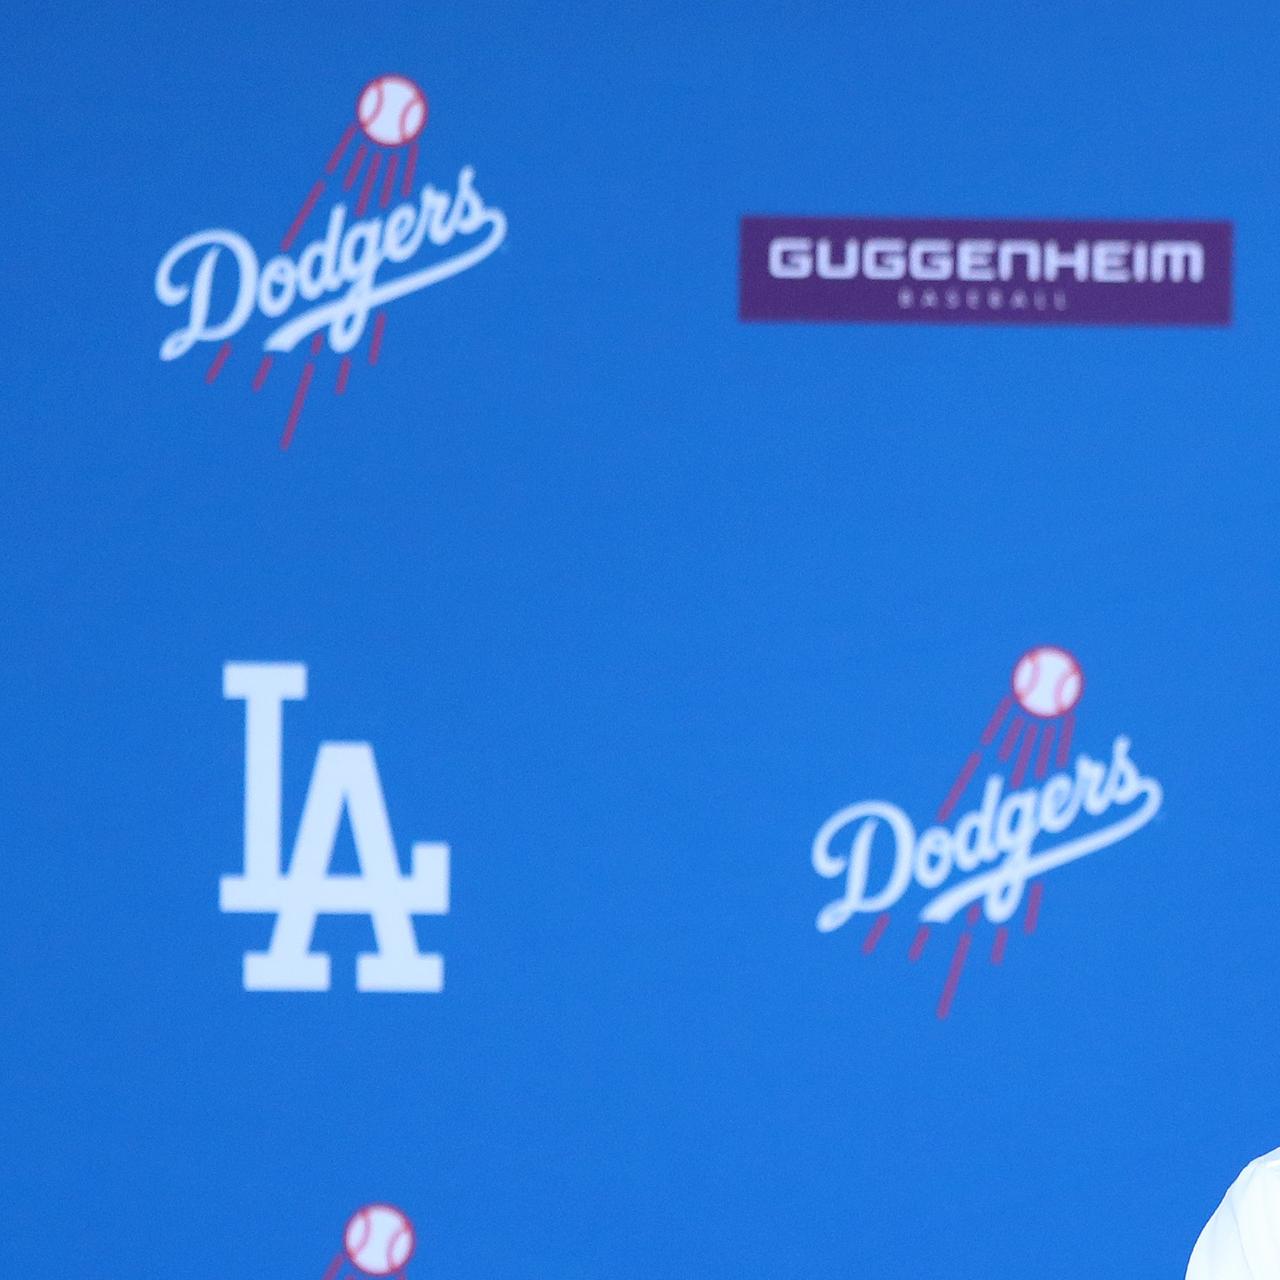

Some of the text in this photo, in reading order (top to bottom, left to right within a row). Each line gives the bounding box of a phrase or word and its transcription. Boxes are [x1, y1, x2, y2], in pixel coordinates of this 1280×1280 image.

[154, 166, 508, 362] Dodgers
[768, 237, 1205, 283] GUGGENHEIM
[218, 661, 452, 994] LA
[811, 735, 1163, 934] Dodgers
